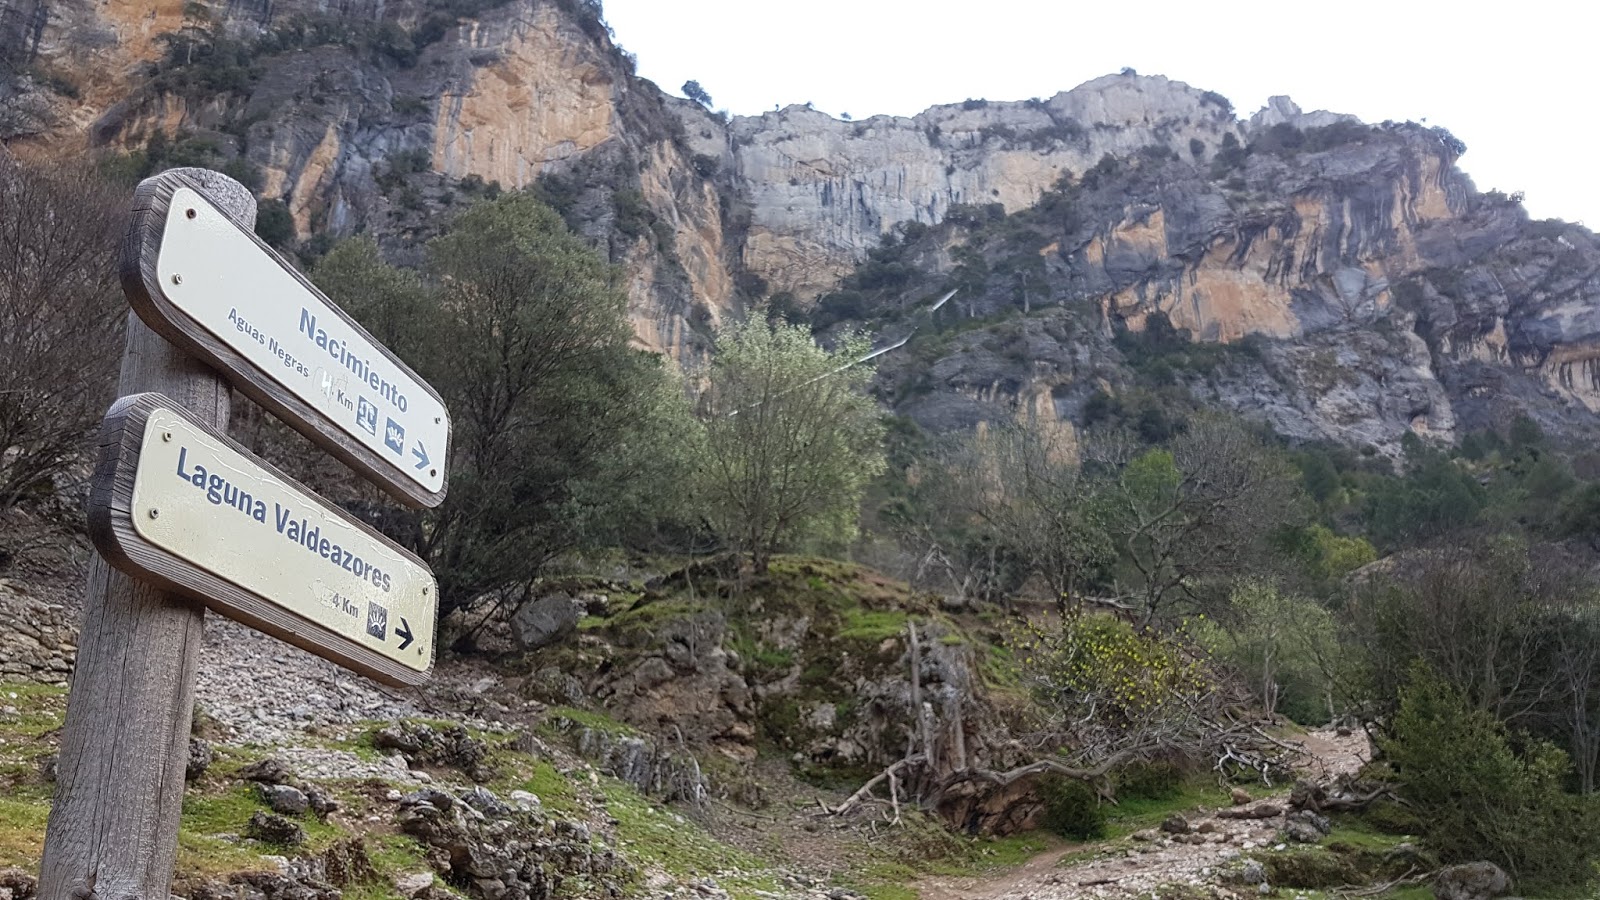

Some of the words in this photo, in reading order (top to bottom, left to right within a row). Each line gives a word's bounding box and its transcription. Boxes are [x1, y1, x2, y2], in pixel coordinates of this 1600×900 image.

[228, 307, 265, 345] Aguas
[268, 336, 310, 378] Negras
[299, 307, 408, 413] Nacimiento
[337, 389, 354, 411] Km
[176, 446, 267, 524] Laguna
[274, 503, 391, 593] Valdeazores
[342, 597, 359, 618] Km
